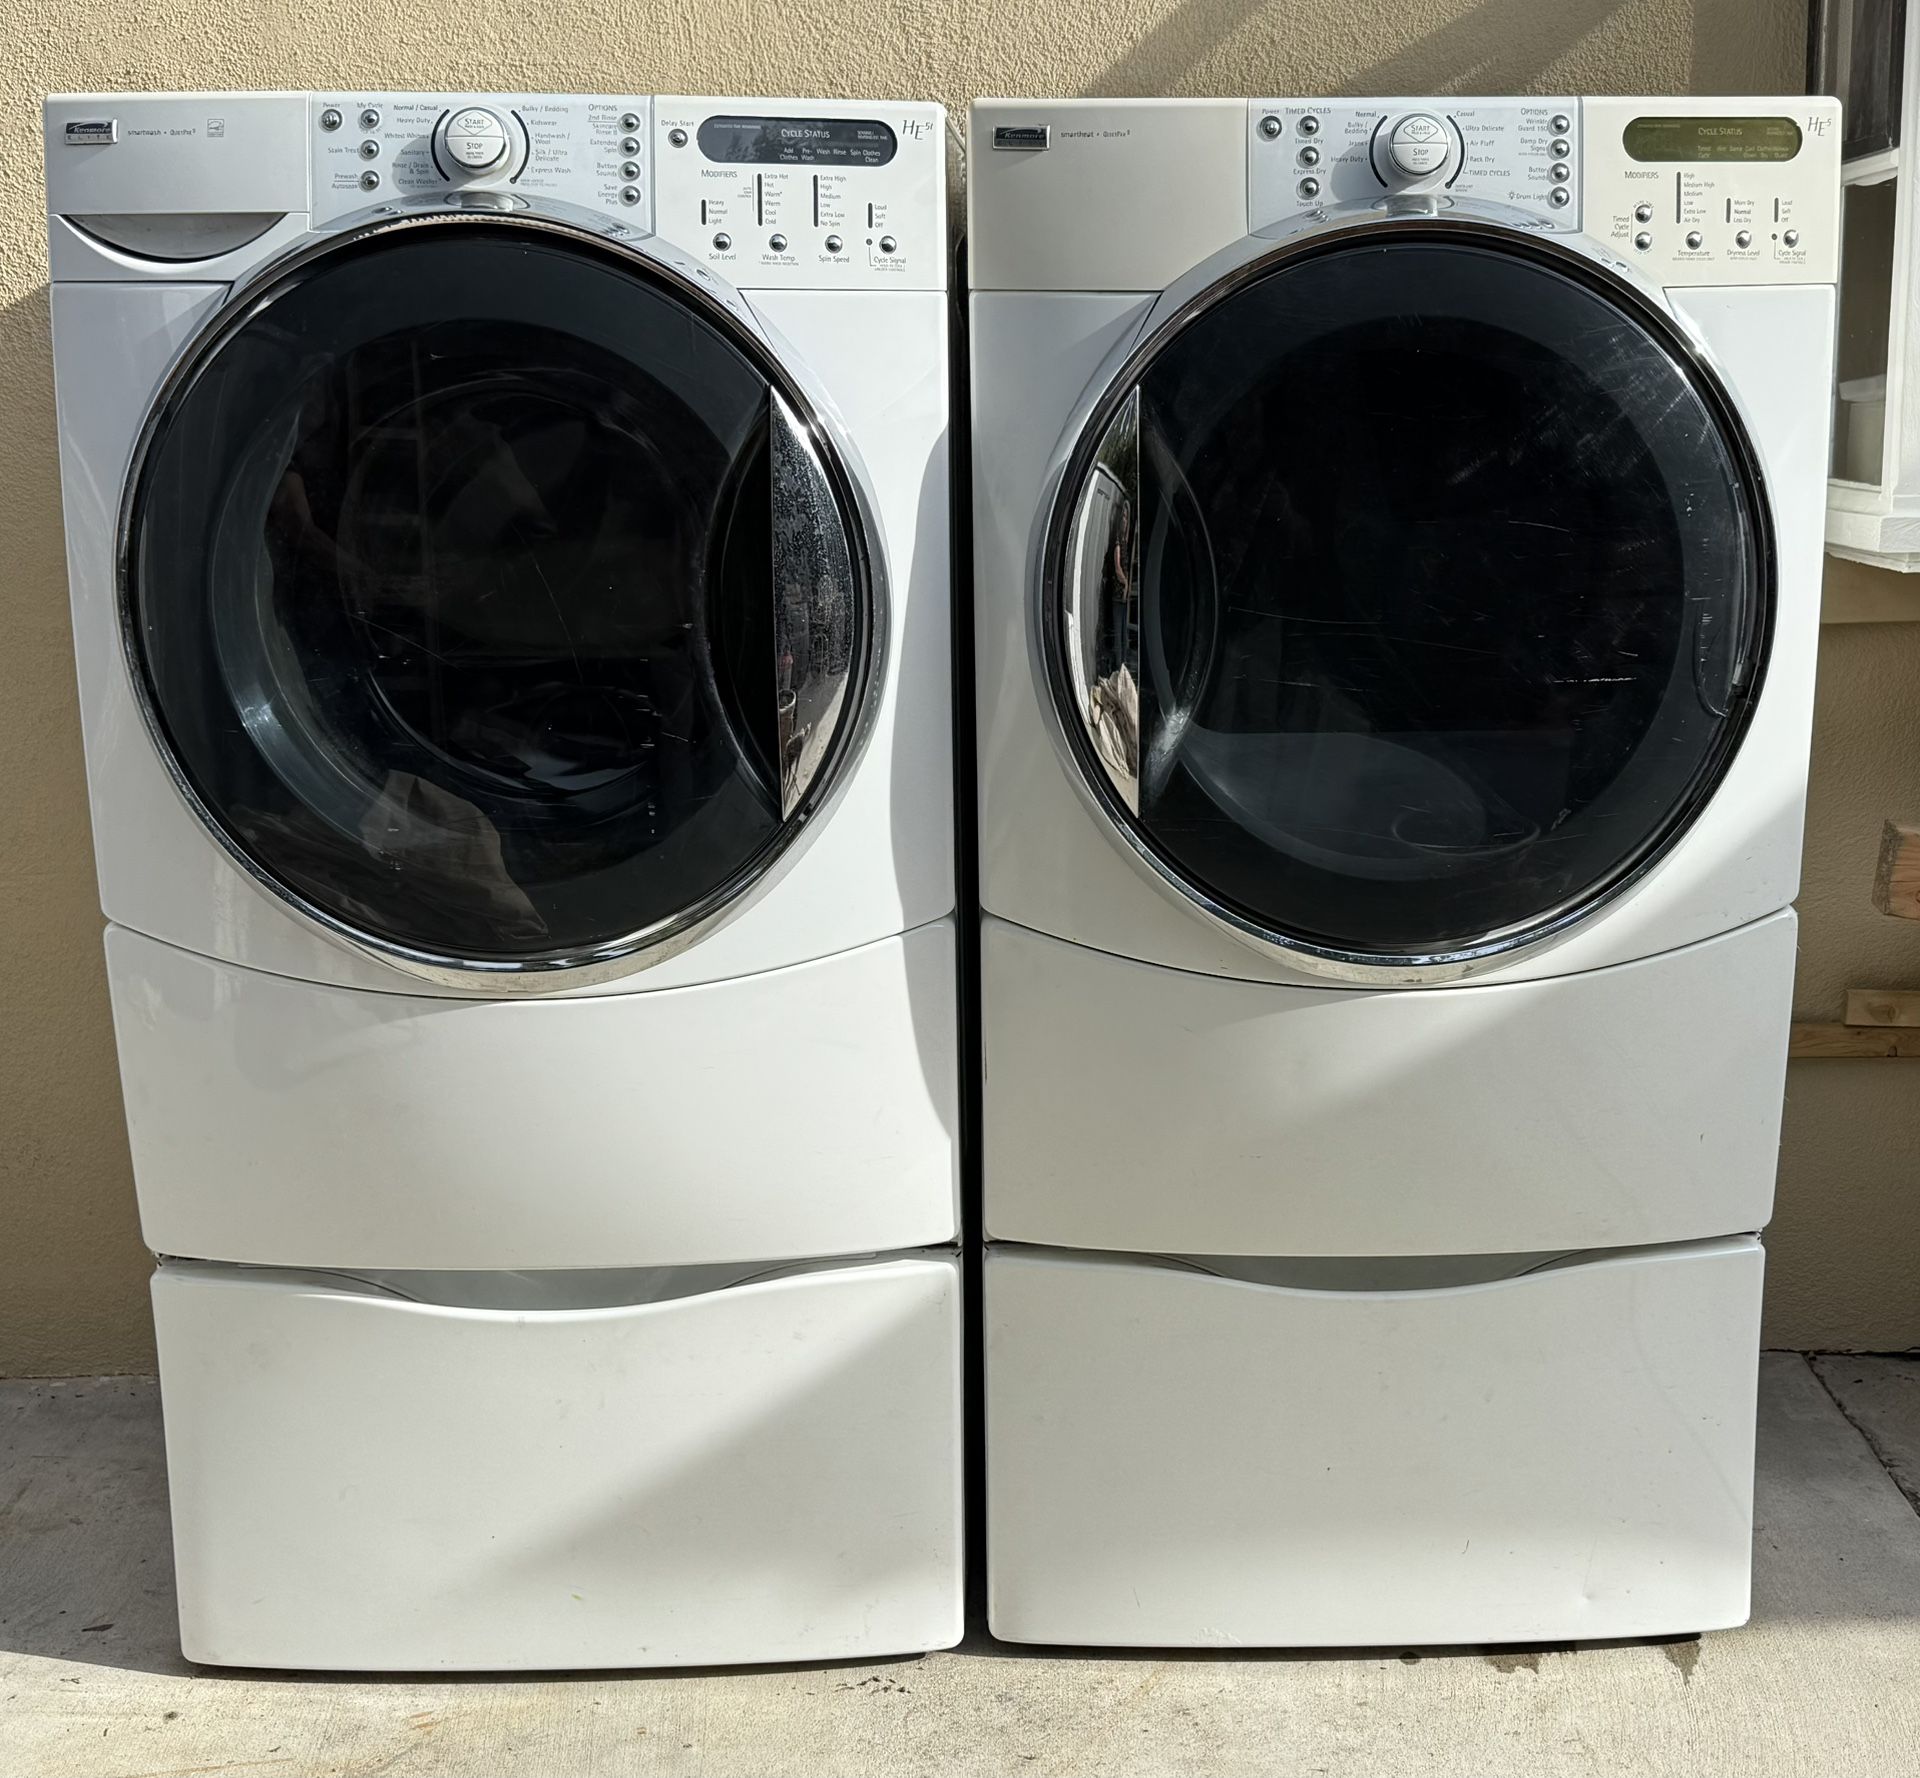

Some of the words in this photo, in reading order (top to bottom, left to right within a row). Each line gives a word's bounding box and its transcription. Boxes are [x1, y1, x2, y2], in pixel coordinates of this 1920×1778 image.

[521, 105, 538, 113] Bulky
[1520, 107, 1548, 116] OPTIONS
[781, 128, 803, 138] CYCLE
[804, 129, 831, 139] STATUS
[1698, 127, 1718, 136] CYCLE
[466, 142, 484, 150] STOP
[1413, 148, 1429, 156] STOP
[834, 175, 847, 183] High
[780, 254, 796, 262] Temp
[833, 255, 850, 263] Speed
[873, 256, 888, 264] Cycle
[889, 256, 907, 264] Signal
